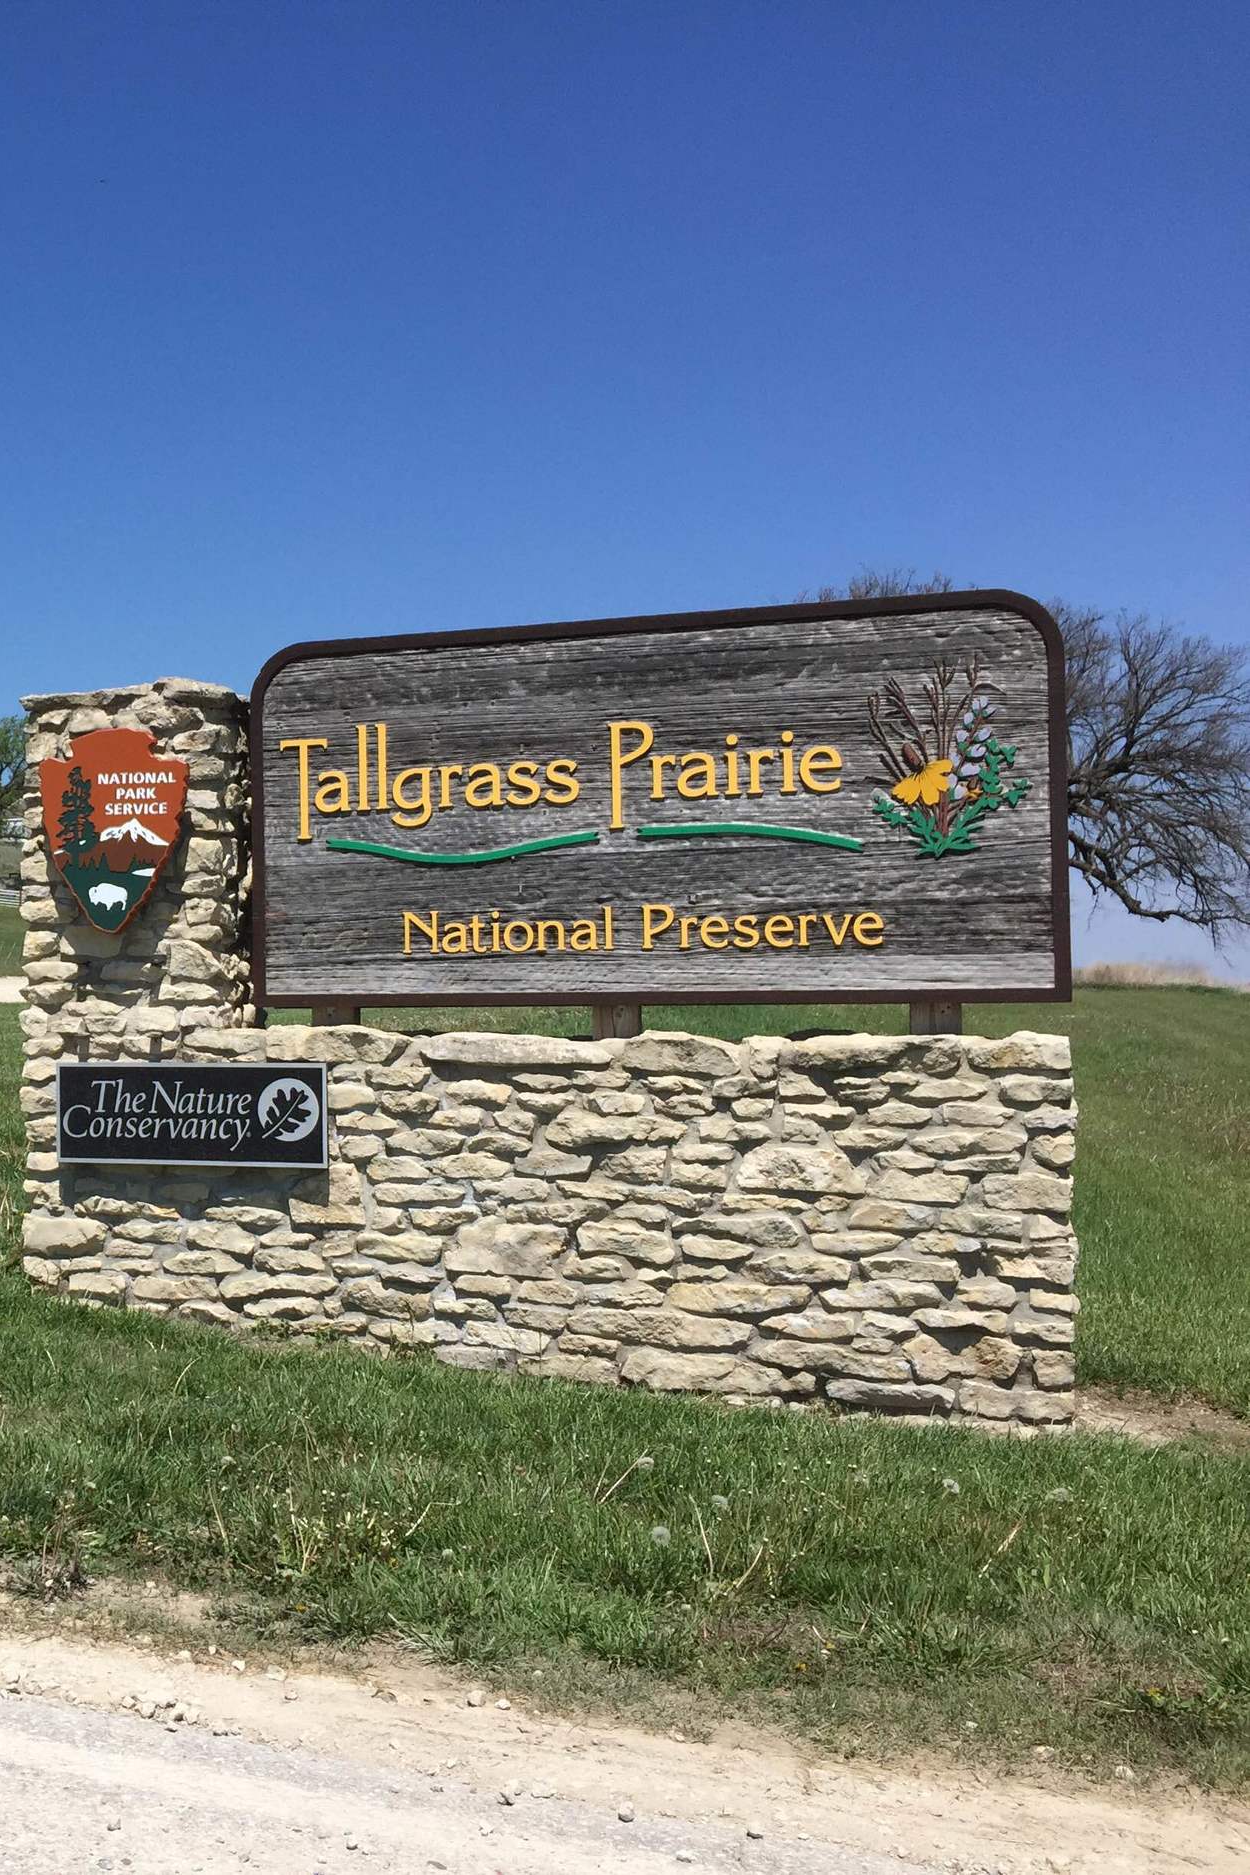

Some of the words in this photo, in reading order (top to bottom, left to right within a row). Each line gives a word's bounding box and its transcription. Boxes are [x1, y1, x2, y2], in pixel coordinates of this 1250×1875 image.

[97, 771, 176, 785] NATIONAL
[115, 787, 156, 800] PARK
[280, 722, 579, 842] Tallgrass
[608, 720, 843, 831] Prairie
[104, 802, 168, 815] SERVICE
[402, 905, 613, 954] National
[641, 904, 885, 951] Preserve
[91, 1079, 145, 1114] The
[149, 1080, 252, 1115] Nature
[62, 1104, 251, 1152] Conservancy
